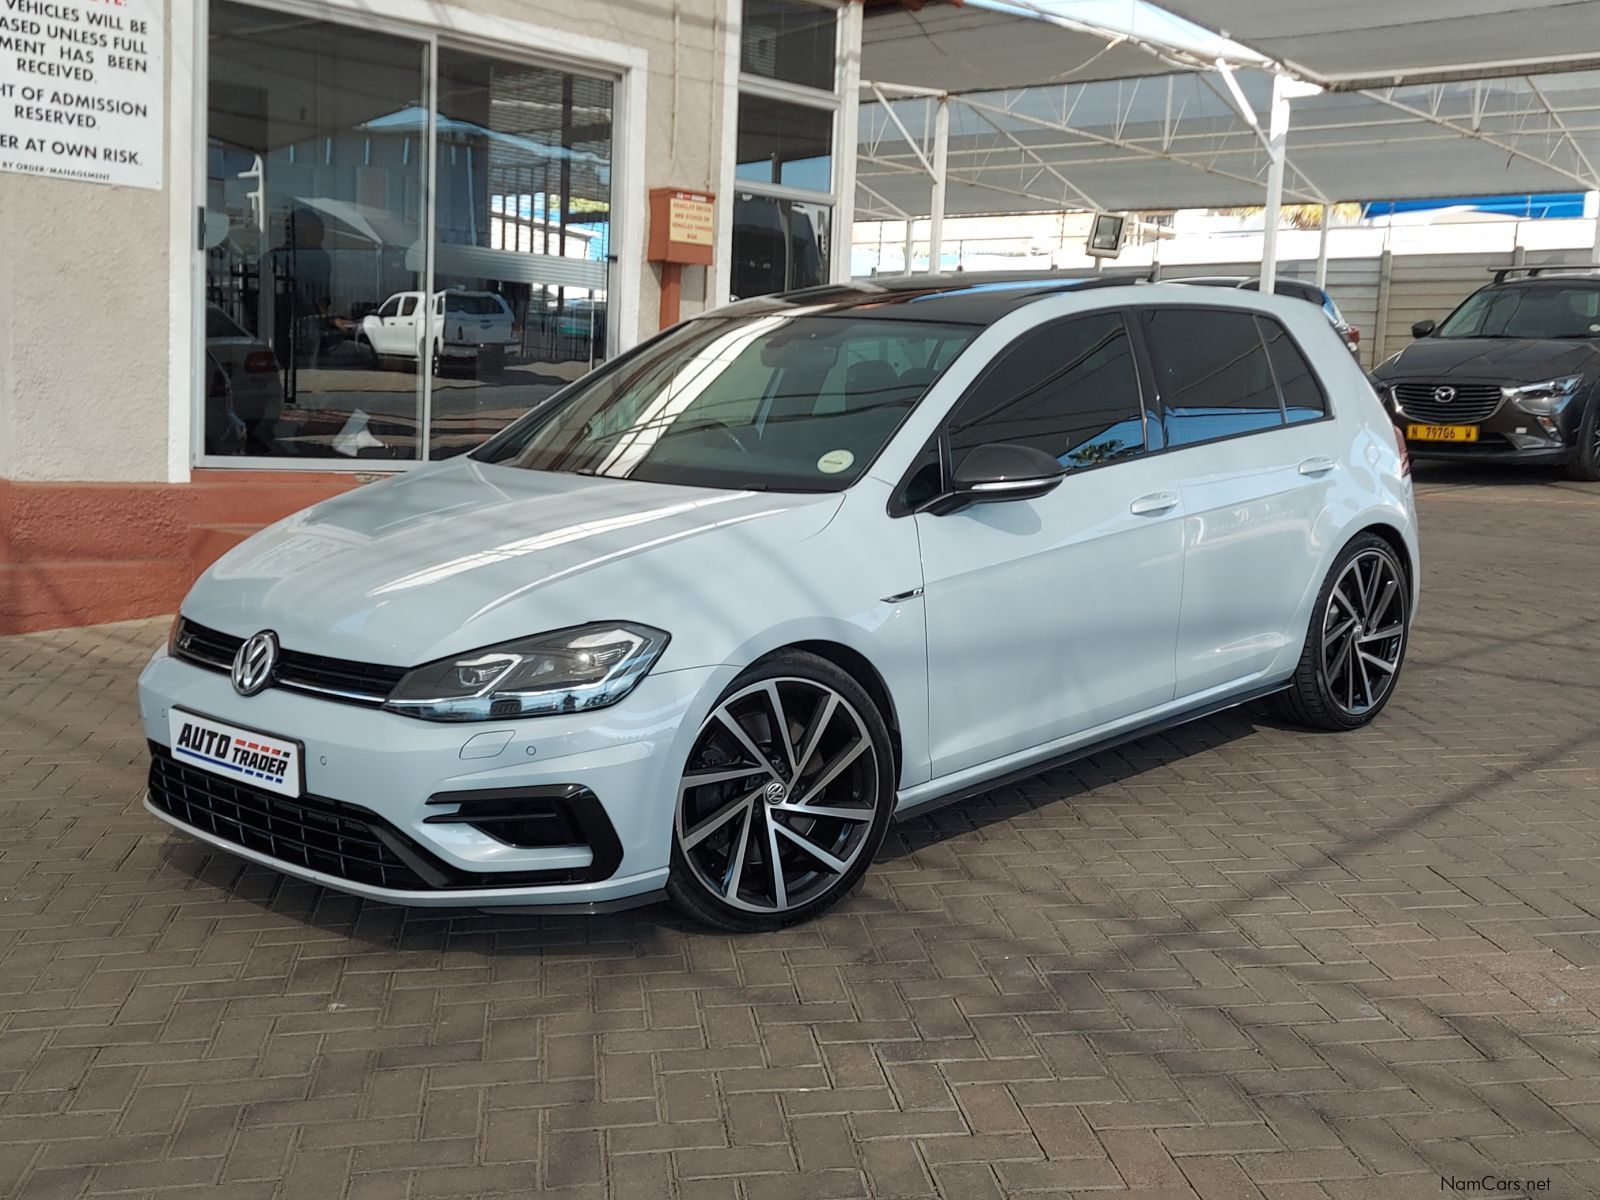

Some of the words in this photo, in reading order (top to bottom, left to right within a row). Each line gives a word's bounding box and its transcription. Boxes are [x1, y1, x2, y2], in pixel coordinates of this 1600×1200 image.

[6, 0, 80, 22] VEHICLES
[86, 11, 124, 31] WILL
[130, 20, 147, 35] BE
[0, 36, 46, 56] MENT
[60, 46, 94, 64] HAS
[108, 55, 147, 73] BEEN
[47, 24, 107, 48] UNLESS
[113, 37, 148, 54] FULL
[17, 58, 97, 84] RECEIVED.
[14, 104, 100, 130] RESERVED.
[21, 86, 44, 101] OF
[50, 91, 147, 118] ADMISSION
[25, 137, 46, 152] AT
[51, 141, 97, 160] OWN
[103, 148, 142, 166] RISK.
[177, 722, 232, 760] AUTO
[232, 747, 288, 777] TRADER
